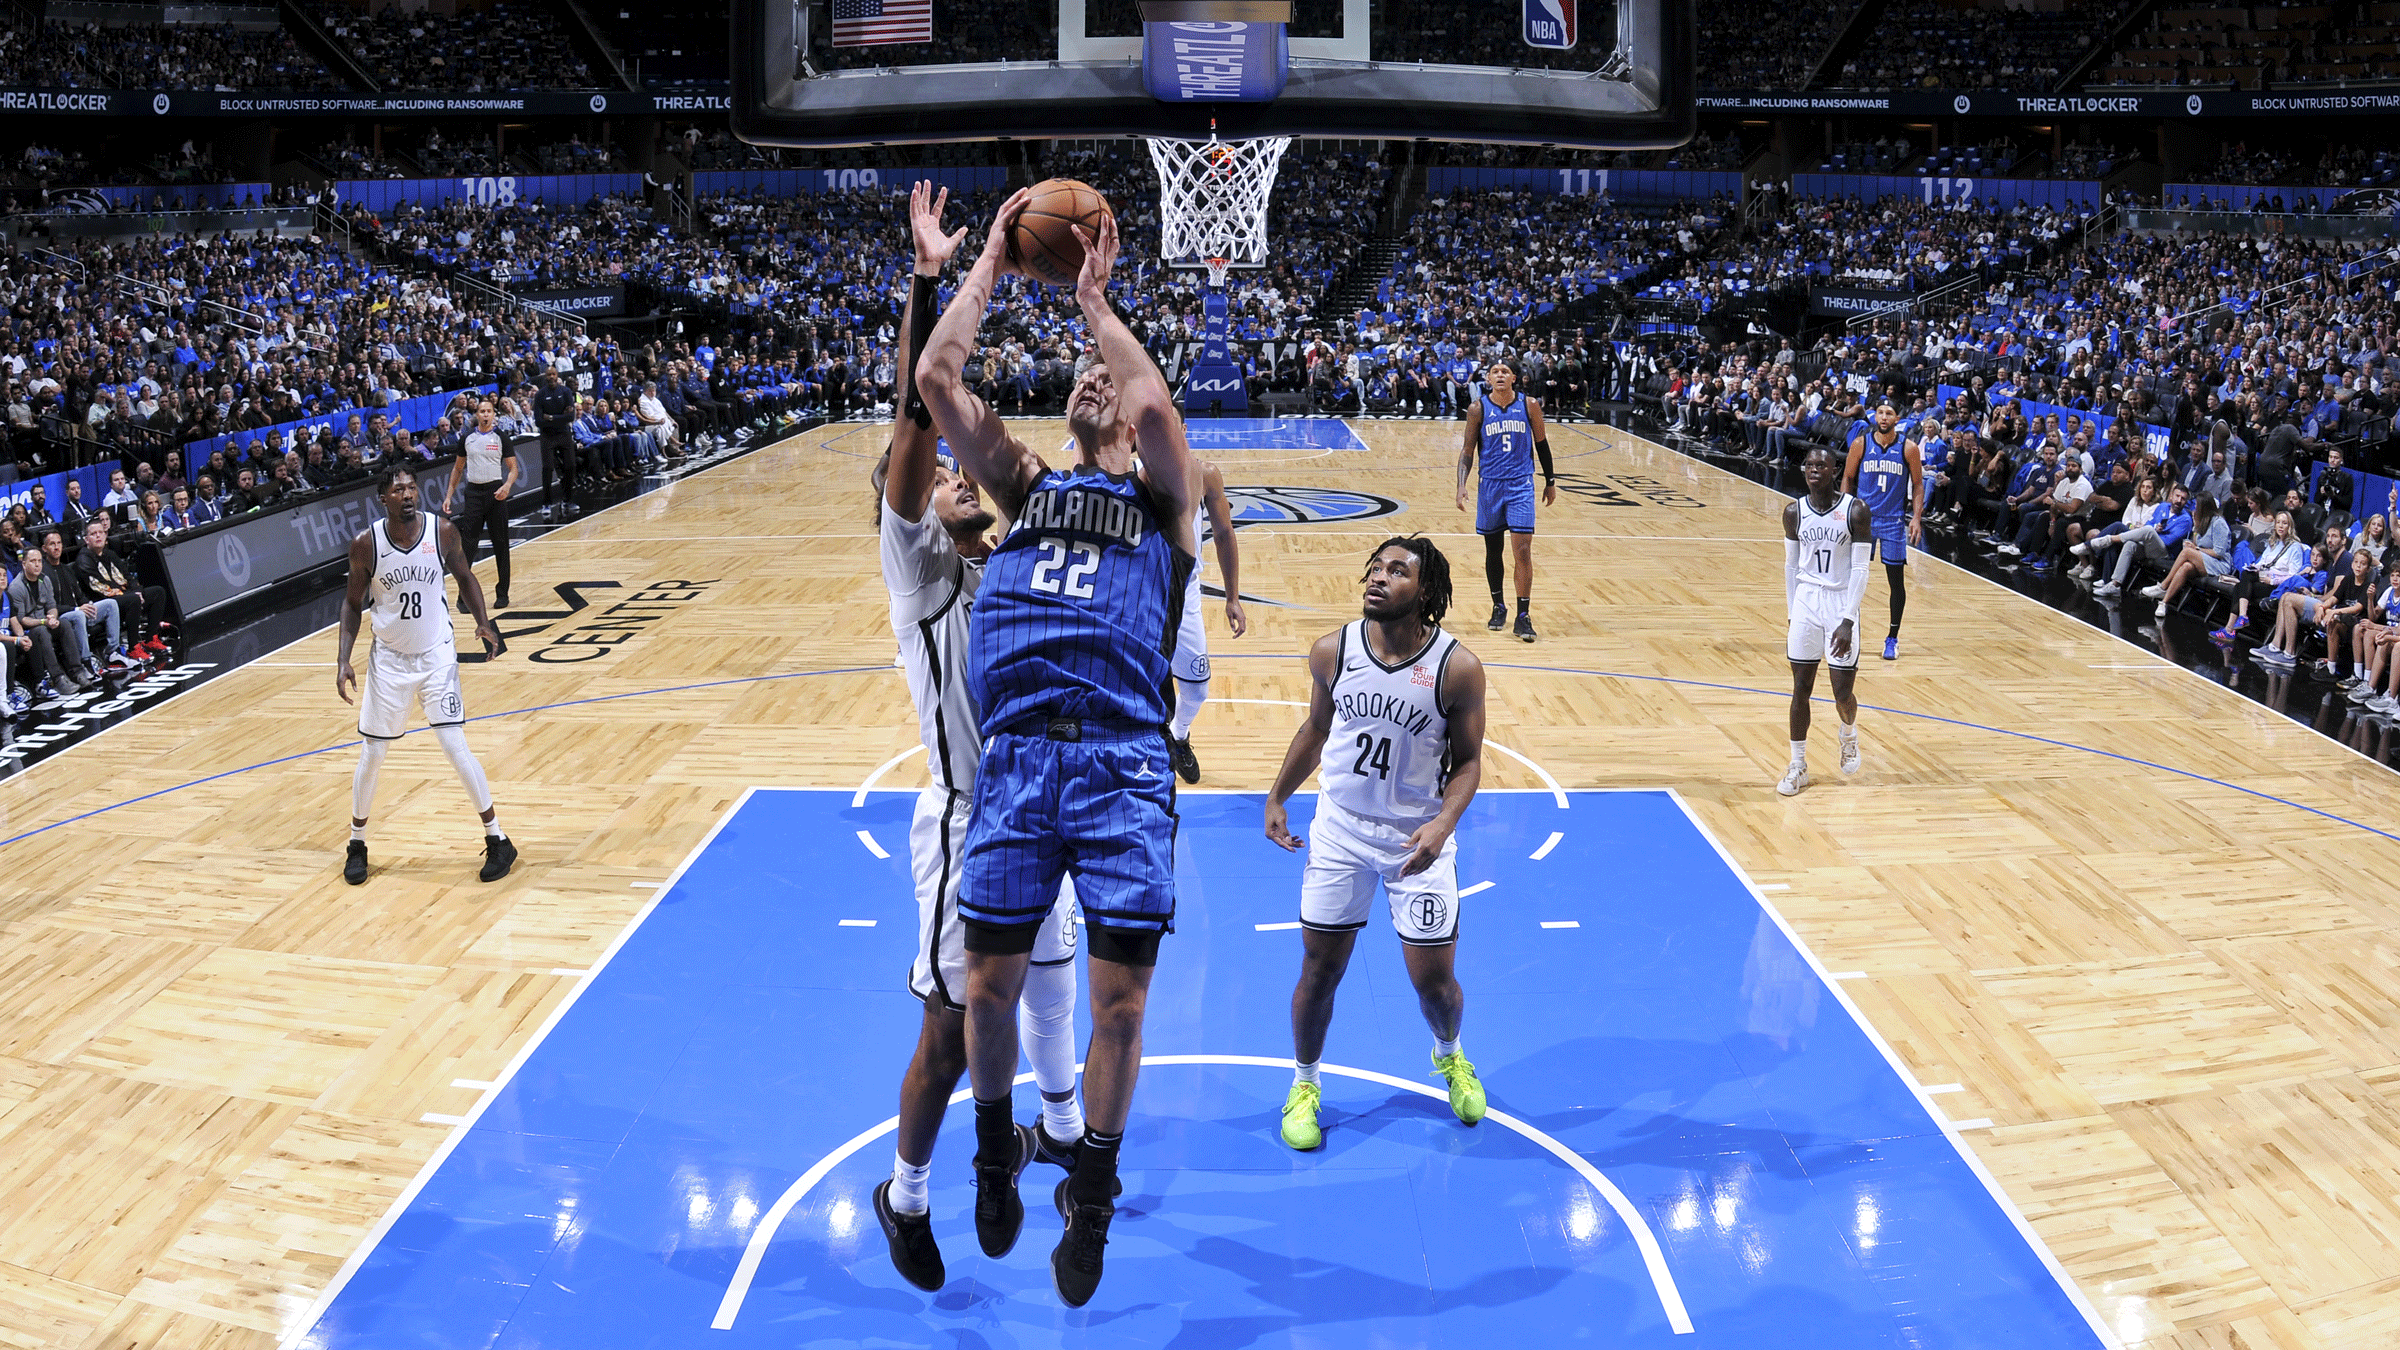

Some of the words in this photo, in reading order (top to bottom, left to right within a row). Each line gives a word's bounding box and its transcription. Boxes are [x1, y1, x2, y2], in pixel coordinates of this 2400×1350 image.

[1531, 20, 1557, 40] NBA
[220, 99, 255, 111] BLOCK
[256, 99, 320, 111] UNTRUSTED
[447, 99, 524, 110] RANSOMWARE
[1811, 98, 1890, 109] RANSOMWARE
[2017, 97, 2139, 112] THREATLOCKER
[2251, 98, 2287, 110] BLOCK
[2288, 97, 2349, 110] UNTRUSTED
[2350, 95, 2400, 108] SOFTWAR
[462, 176, 516, 207] 108
[823, 168, 879, 195] 109
[1559, 169, 1608, 197] 111
[1920, 176, 1973, 212] 112
[146, 217, 165, 231] 107
[1485, 419, 1526, 437] ORLANDO
[1502, 434, 1512, 452] 5
[1863, 460, 1903, 476] ORLANDO
[1606, 474, 1708, 508] CENTER
[1877, 474, 1887, 493] 4
[291, 472, 468, 557] THREACKE
[1798, 526, 1850, 547] BROOKLYN
[1030, 536, 1100, 599] 22
[1814, 549, 1832, 574] 17
[379, 565, 438, 591] BROOKLYN
[399, 591, 422, 620] 28
[528, 578, 722, 664] CENTER
[1412, 671, 1435, 682] YOUR
[1413, 664, 1429, 674] GET
[1410, 677, 1435, 689] GUIDE
[1334, 692, 1433, 737] BROOKLYN
[1353, 732, 1392, 781] 24
